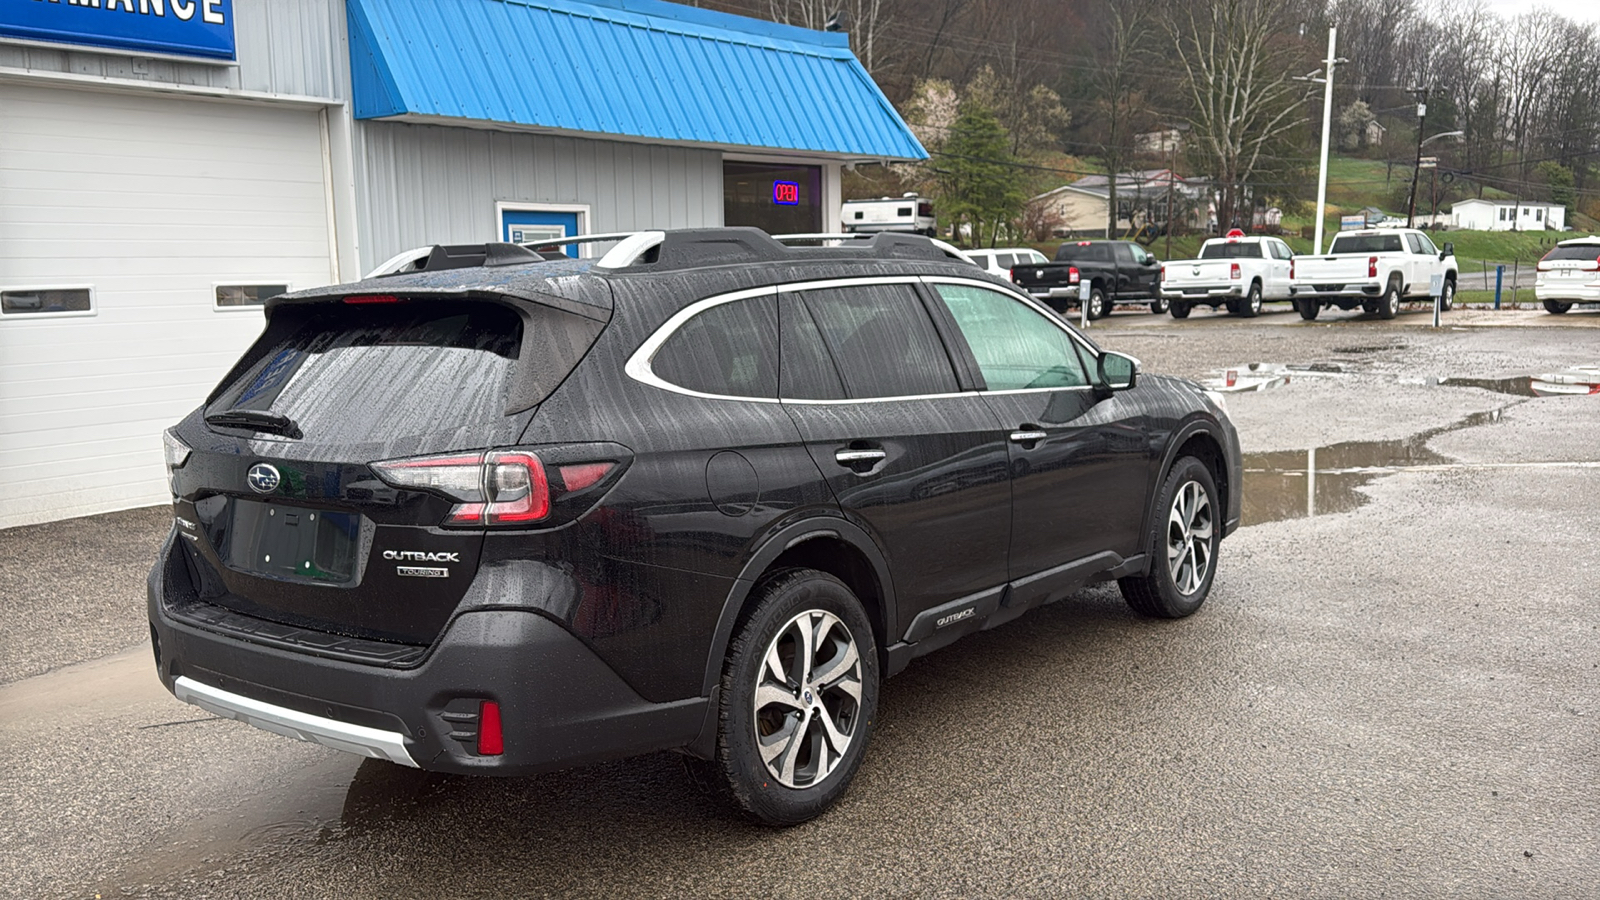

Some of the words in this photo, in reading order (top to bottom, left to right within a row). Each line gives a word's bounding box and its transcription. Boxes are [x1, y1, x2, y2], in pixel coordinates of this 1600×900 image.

[776, 184, 798, 202] OPEN
[382, 550, 460, 563] OUTBACK
[402, 568, 442, 576] TOURING
[936, 607, 976, 626] OUTBACK
